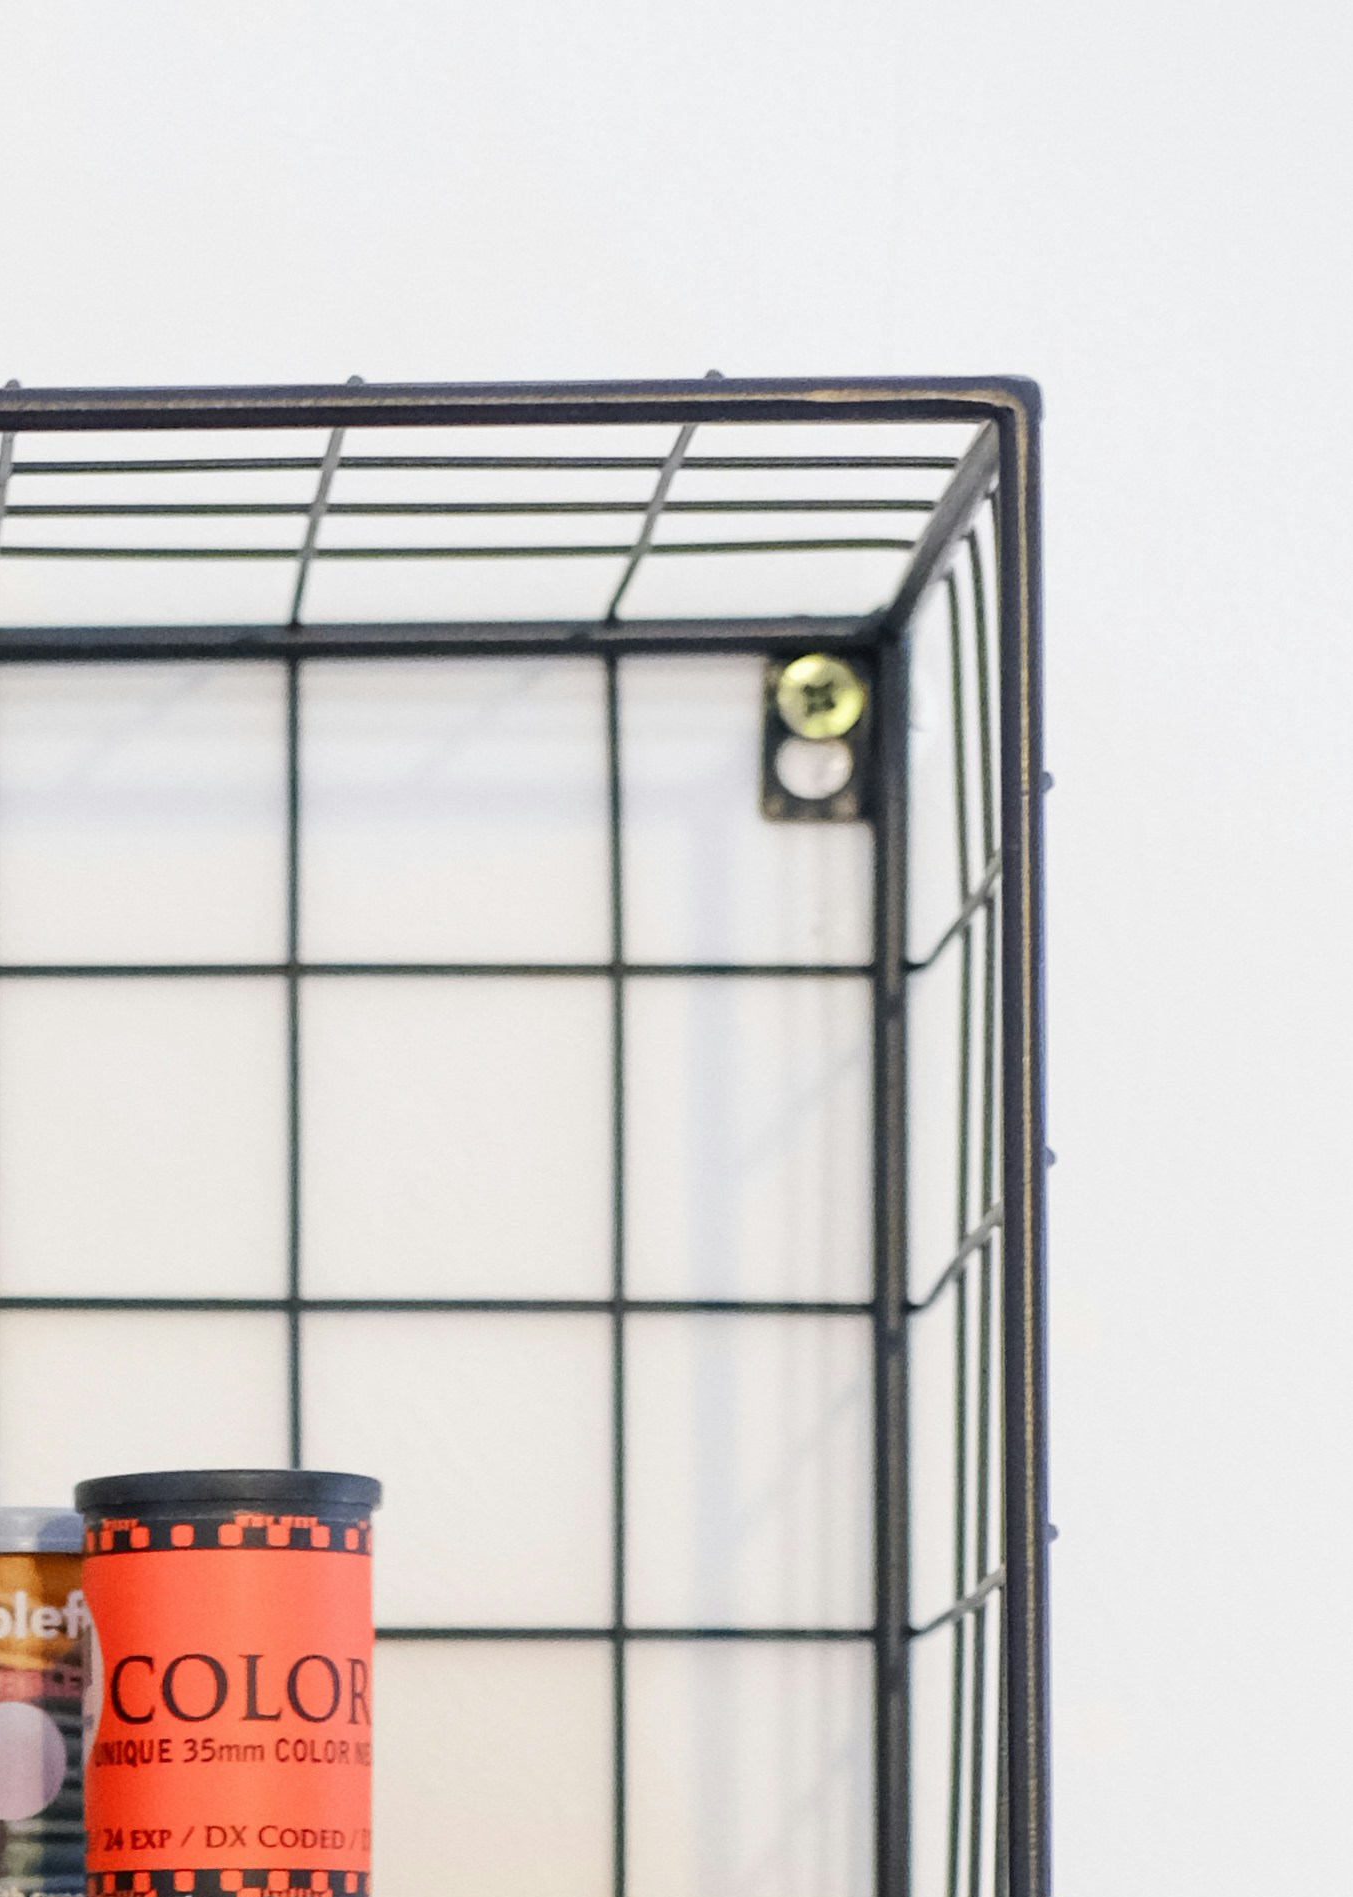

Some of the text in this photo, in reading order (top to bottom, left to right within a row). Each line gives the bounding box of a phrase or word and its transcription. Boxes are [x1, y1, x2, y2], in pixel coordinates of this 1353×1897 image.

[110, 1654, 371, 1725] COLOR
[183, 1738, 265, 1764] 35mm
[275, 1738, 350, 1765] COLOR
[130, 1829, 172, 1850] EXP
[205, 1825, 248, 1849] DX
